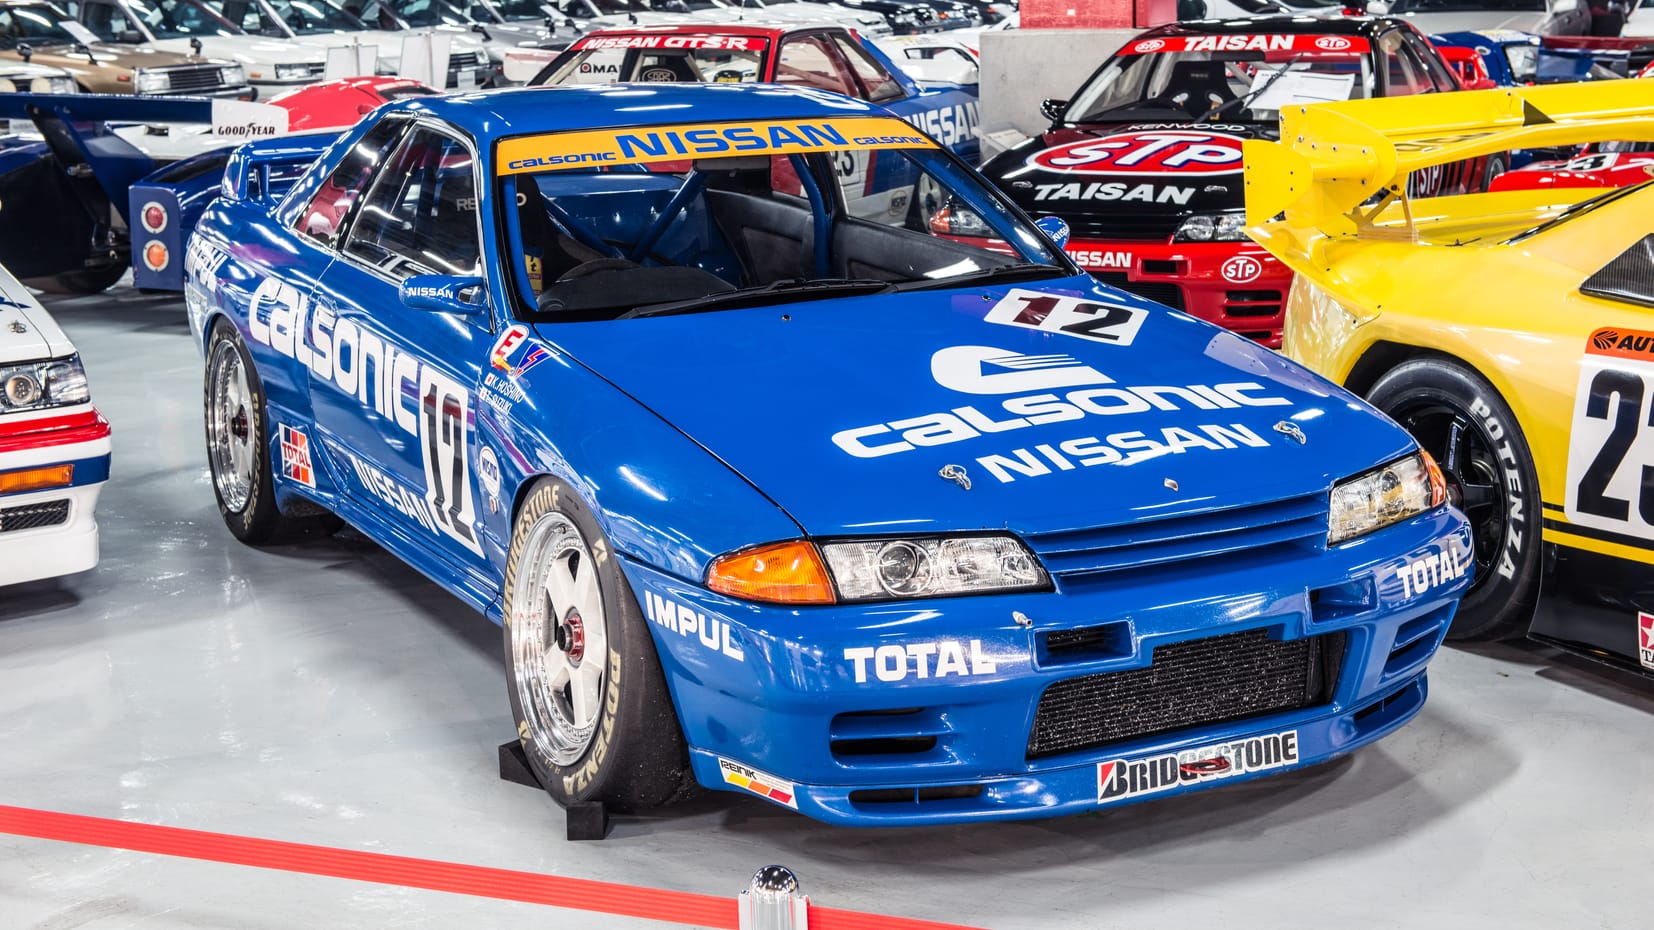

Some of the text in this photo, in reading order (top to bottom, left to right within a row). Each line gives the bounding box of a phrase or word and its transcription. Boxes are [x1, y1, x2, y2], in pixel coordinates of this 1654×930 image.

[581, 37, 659, 50] NISSAN
[1184, 35, 1296, 51] TAISAN
[1318, 37, 1349, 49] STP
[218, 123, 275, 138] GOODYEAR
[615, 123, 849, 160] NISSAN
[1127, 122, 1247, 132] KENWOOD
[1049, 134, 1244, 168] STP
[1034, 182, 1196, 205] TAISAN
[1066, 249, 1132, 268] ISSAN
[1226, 259, 1256, 278] STP
[407, 286, 454, 299] NISSAN
[1012, 294, 1134, 342] 12
[282, 442, 311, 469] TOTAL
[423, 381, 477, 546] 12
[974, 422, 1271, 484] NISSAN
[347, 453, 441, 537] NISSAN
[1469, 396, 1525, 581] POTENZA
[1396, 547, 1467, 600] TOTAL
[643, 589, 745, 663] IMPUL
[843, 639, 997, 684] TOTAL
[562, 647, 622, 796] POTENZA
